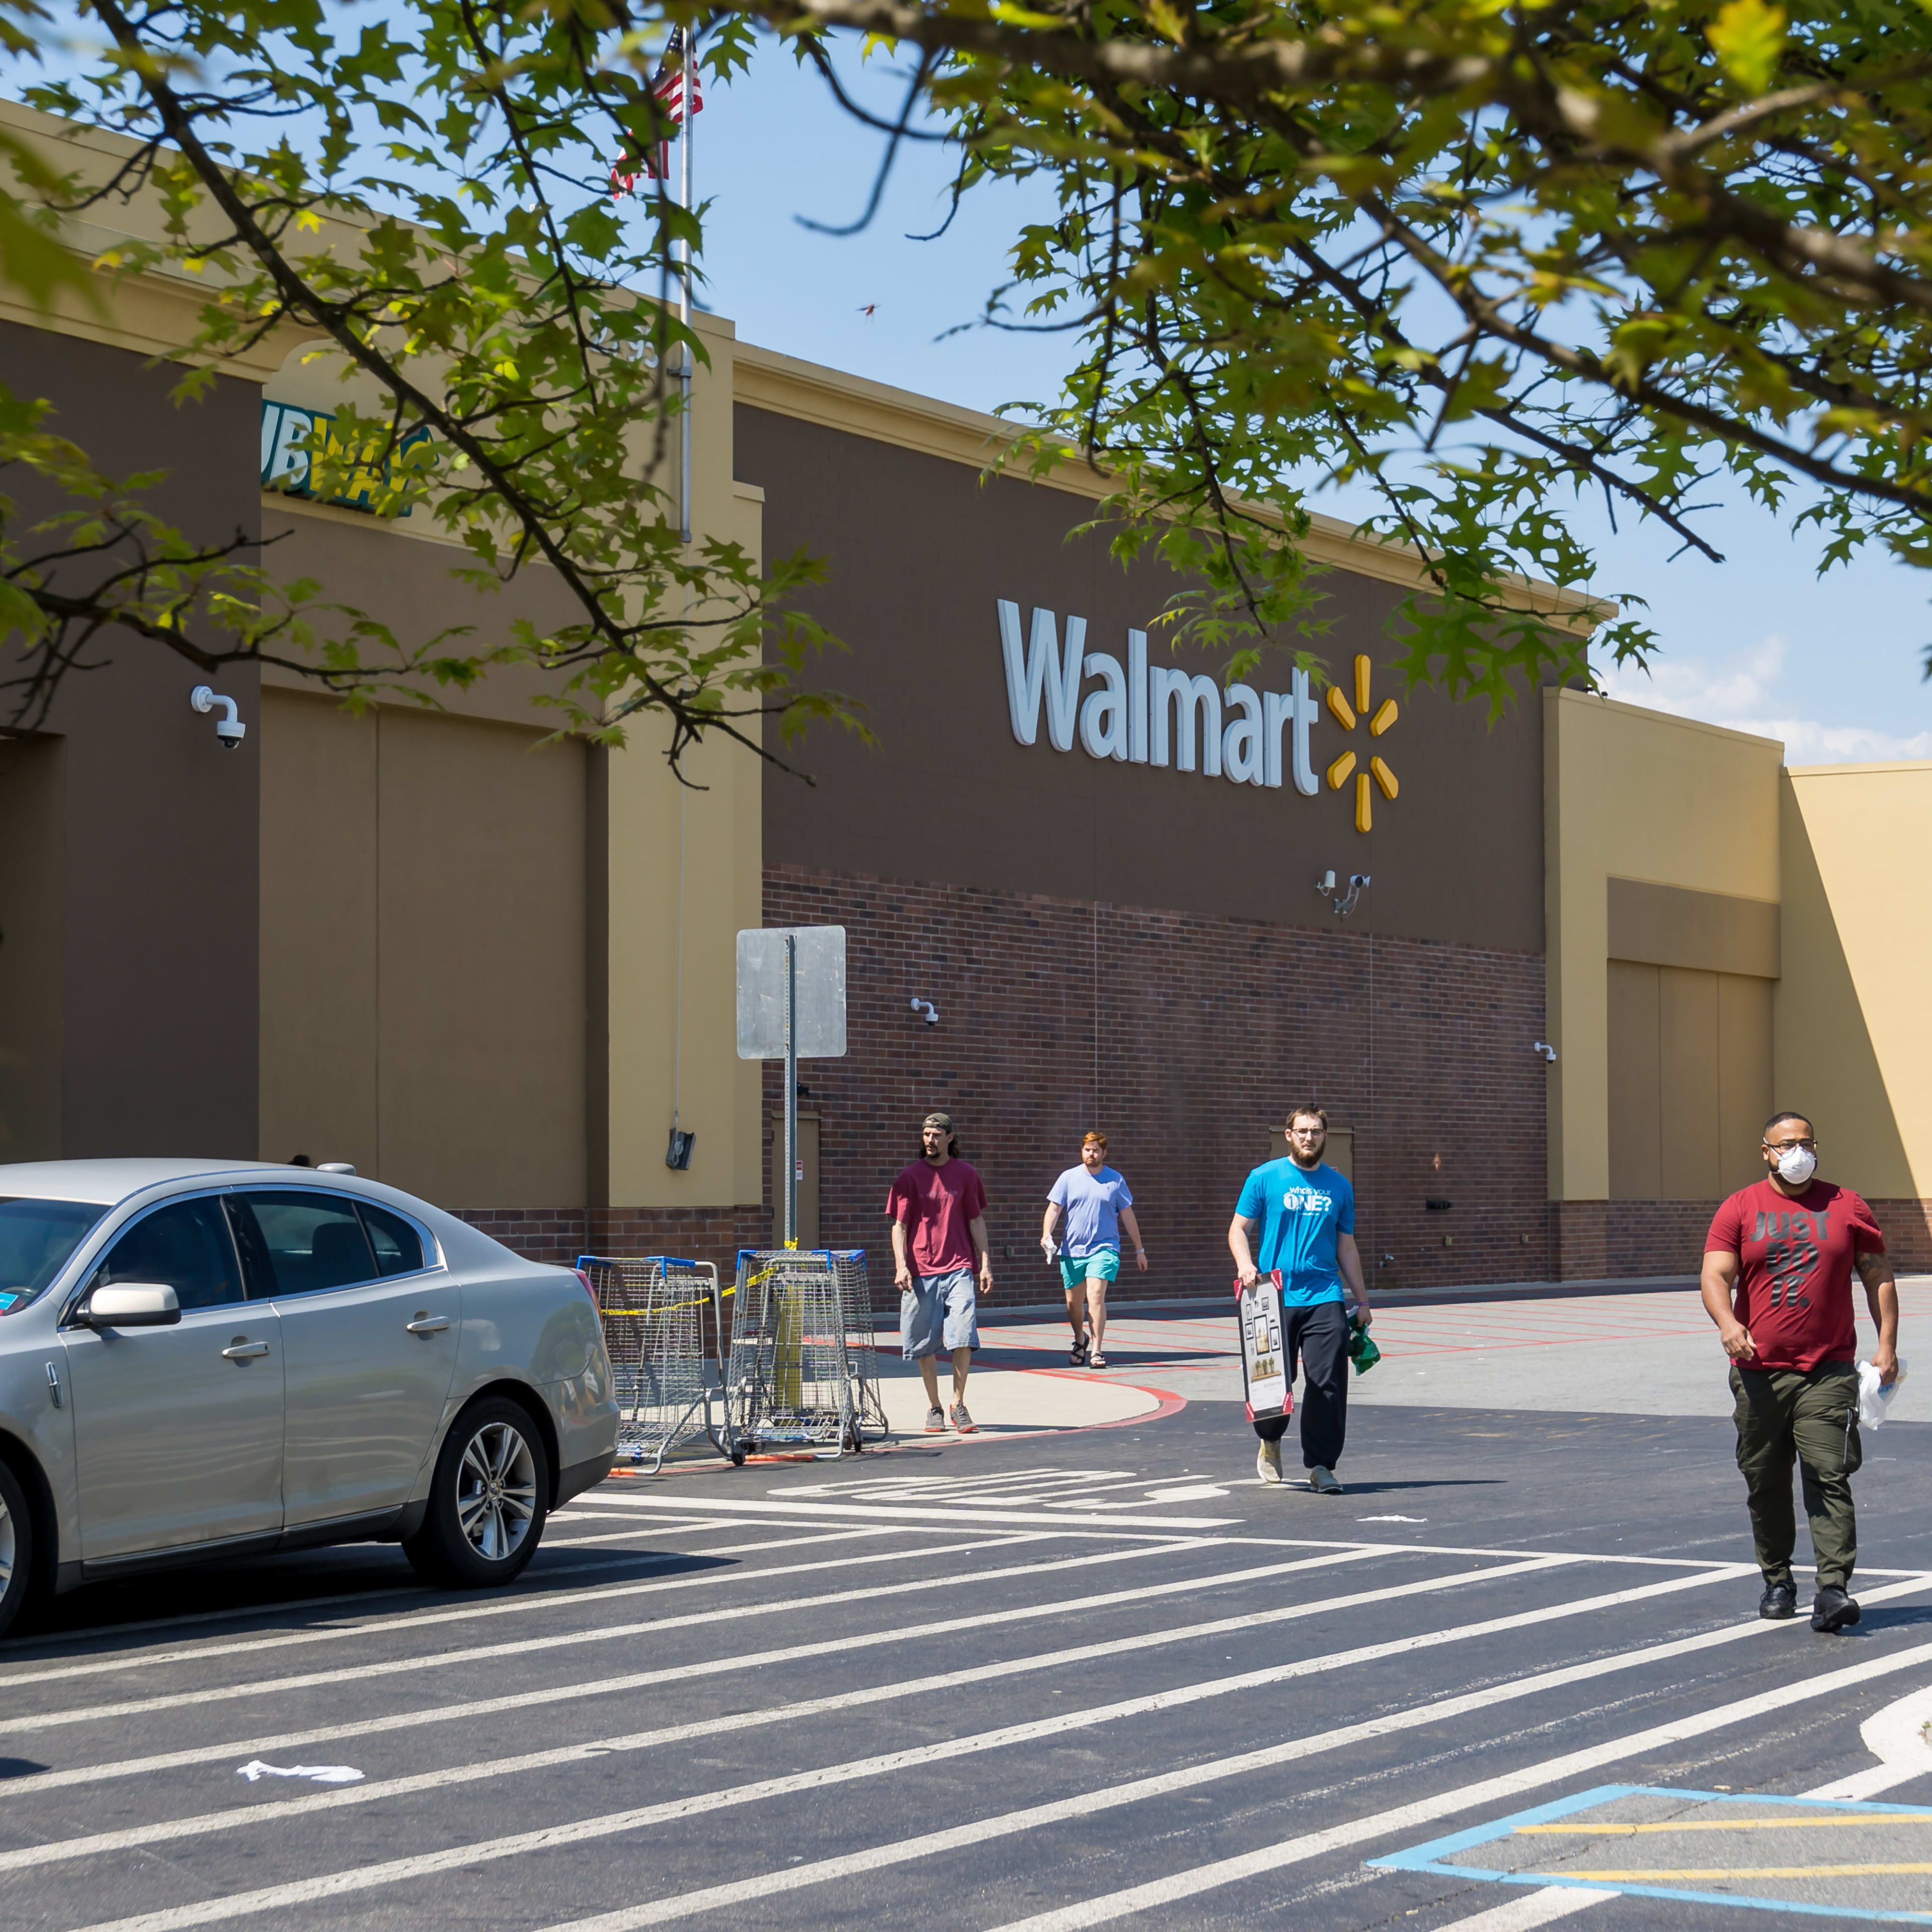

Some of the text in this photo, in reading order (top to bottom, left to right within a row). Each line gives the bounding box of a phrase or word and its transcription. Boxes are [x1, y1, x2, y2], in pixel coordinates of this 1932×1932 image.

[997, 599, 1319, 796] Walmart
[1289, 1186, 1313, 1195] who's
[1750, 1211, 1830, 1242] JUST
[1766, 1241, 1819, 1274] DO
[1771, 1274, 1810, 1307] IT.
